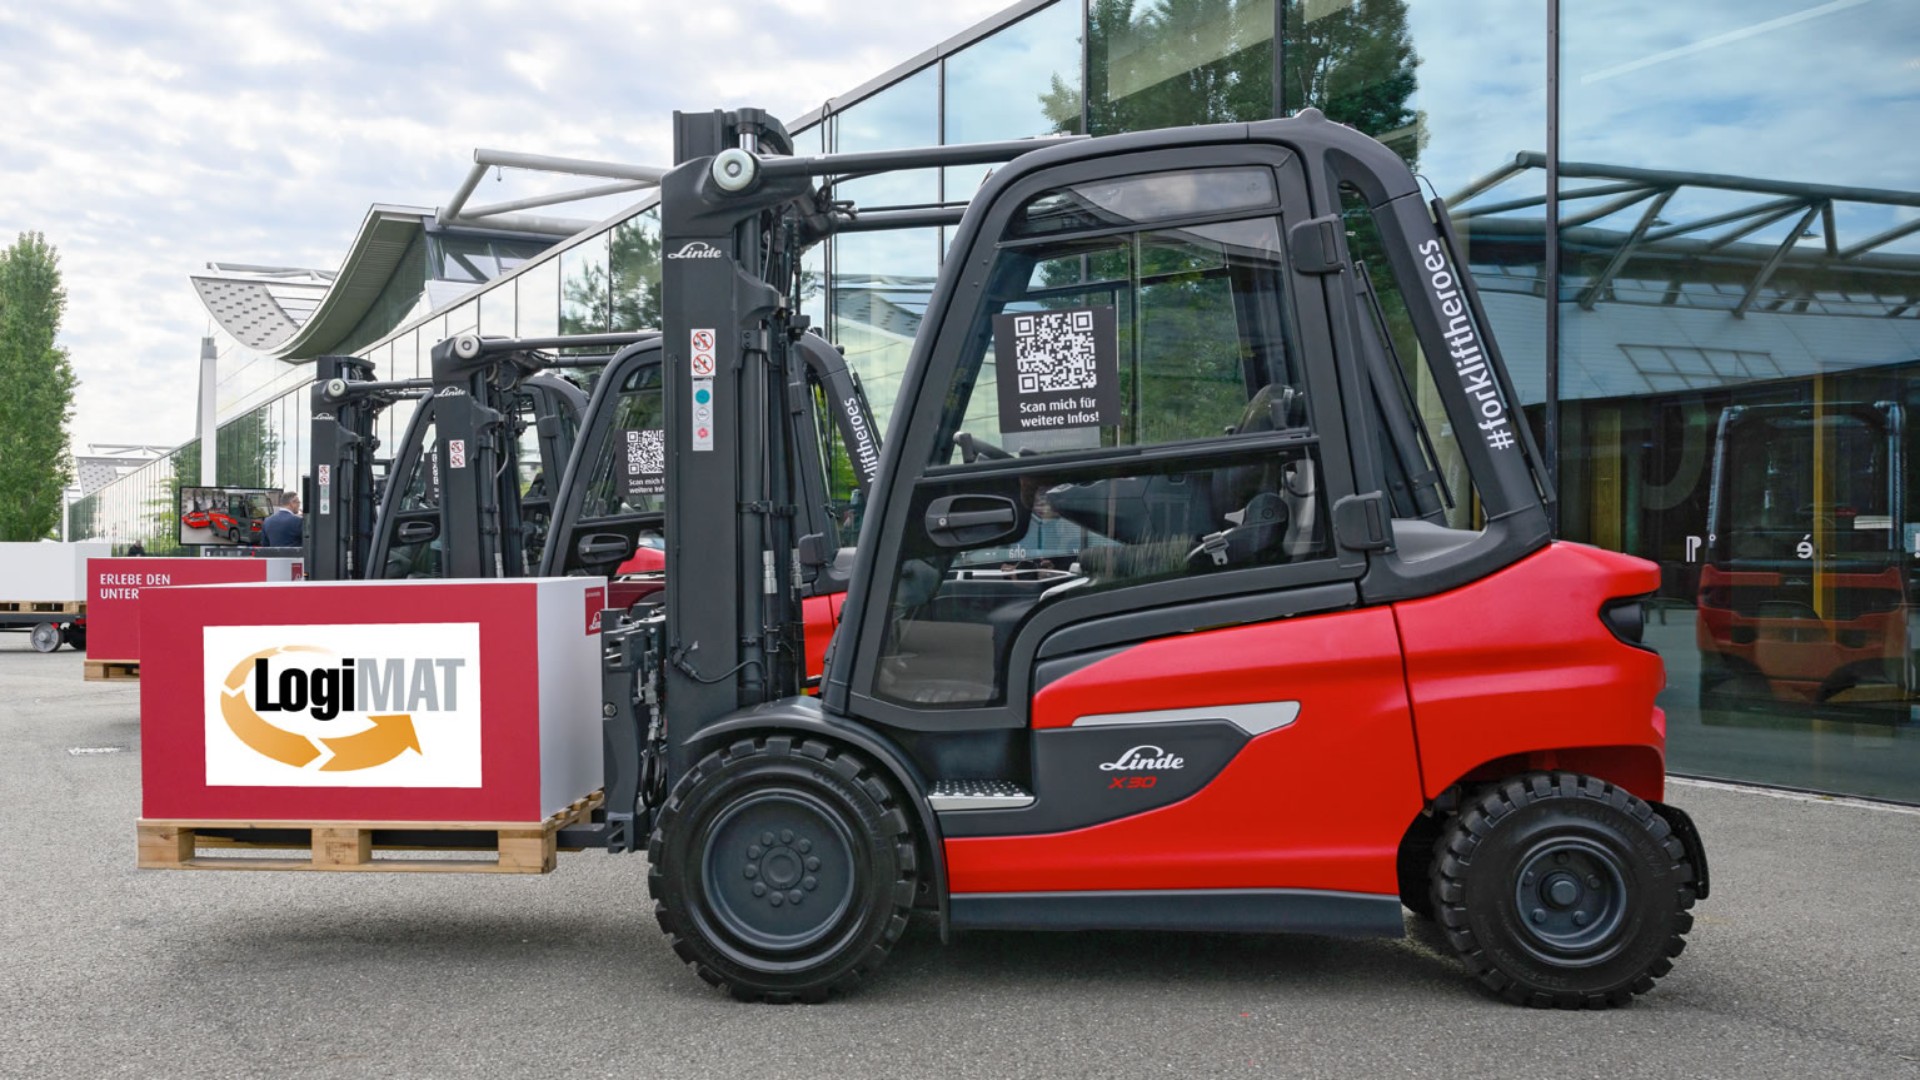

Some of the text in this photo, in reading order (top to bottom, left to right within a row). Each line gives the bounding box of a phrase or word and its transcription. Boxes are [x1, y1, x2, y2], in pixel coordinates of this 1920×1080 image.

[667, 241, 722, 260] Linde
[1418, 239, 1515, 451] #forkliftheroes
[1020, 397, 1096, 414] Scan mich für
[1021, 411, 1099, 428] weitere Infos!
[100, 573, 170, 585] ERLEBE DEN
[100, 588, 139, 599] UNTER
[255, 658, 465, 721] LogiMAT
[1099, 745, 1184, 771] Linde
